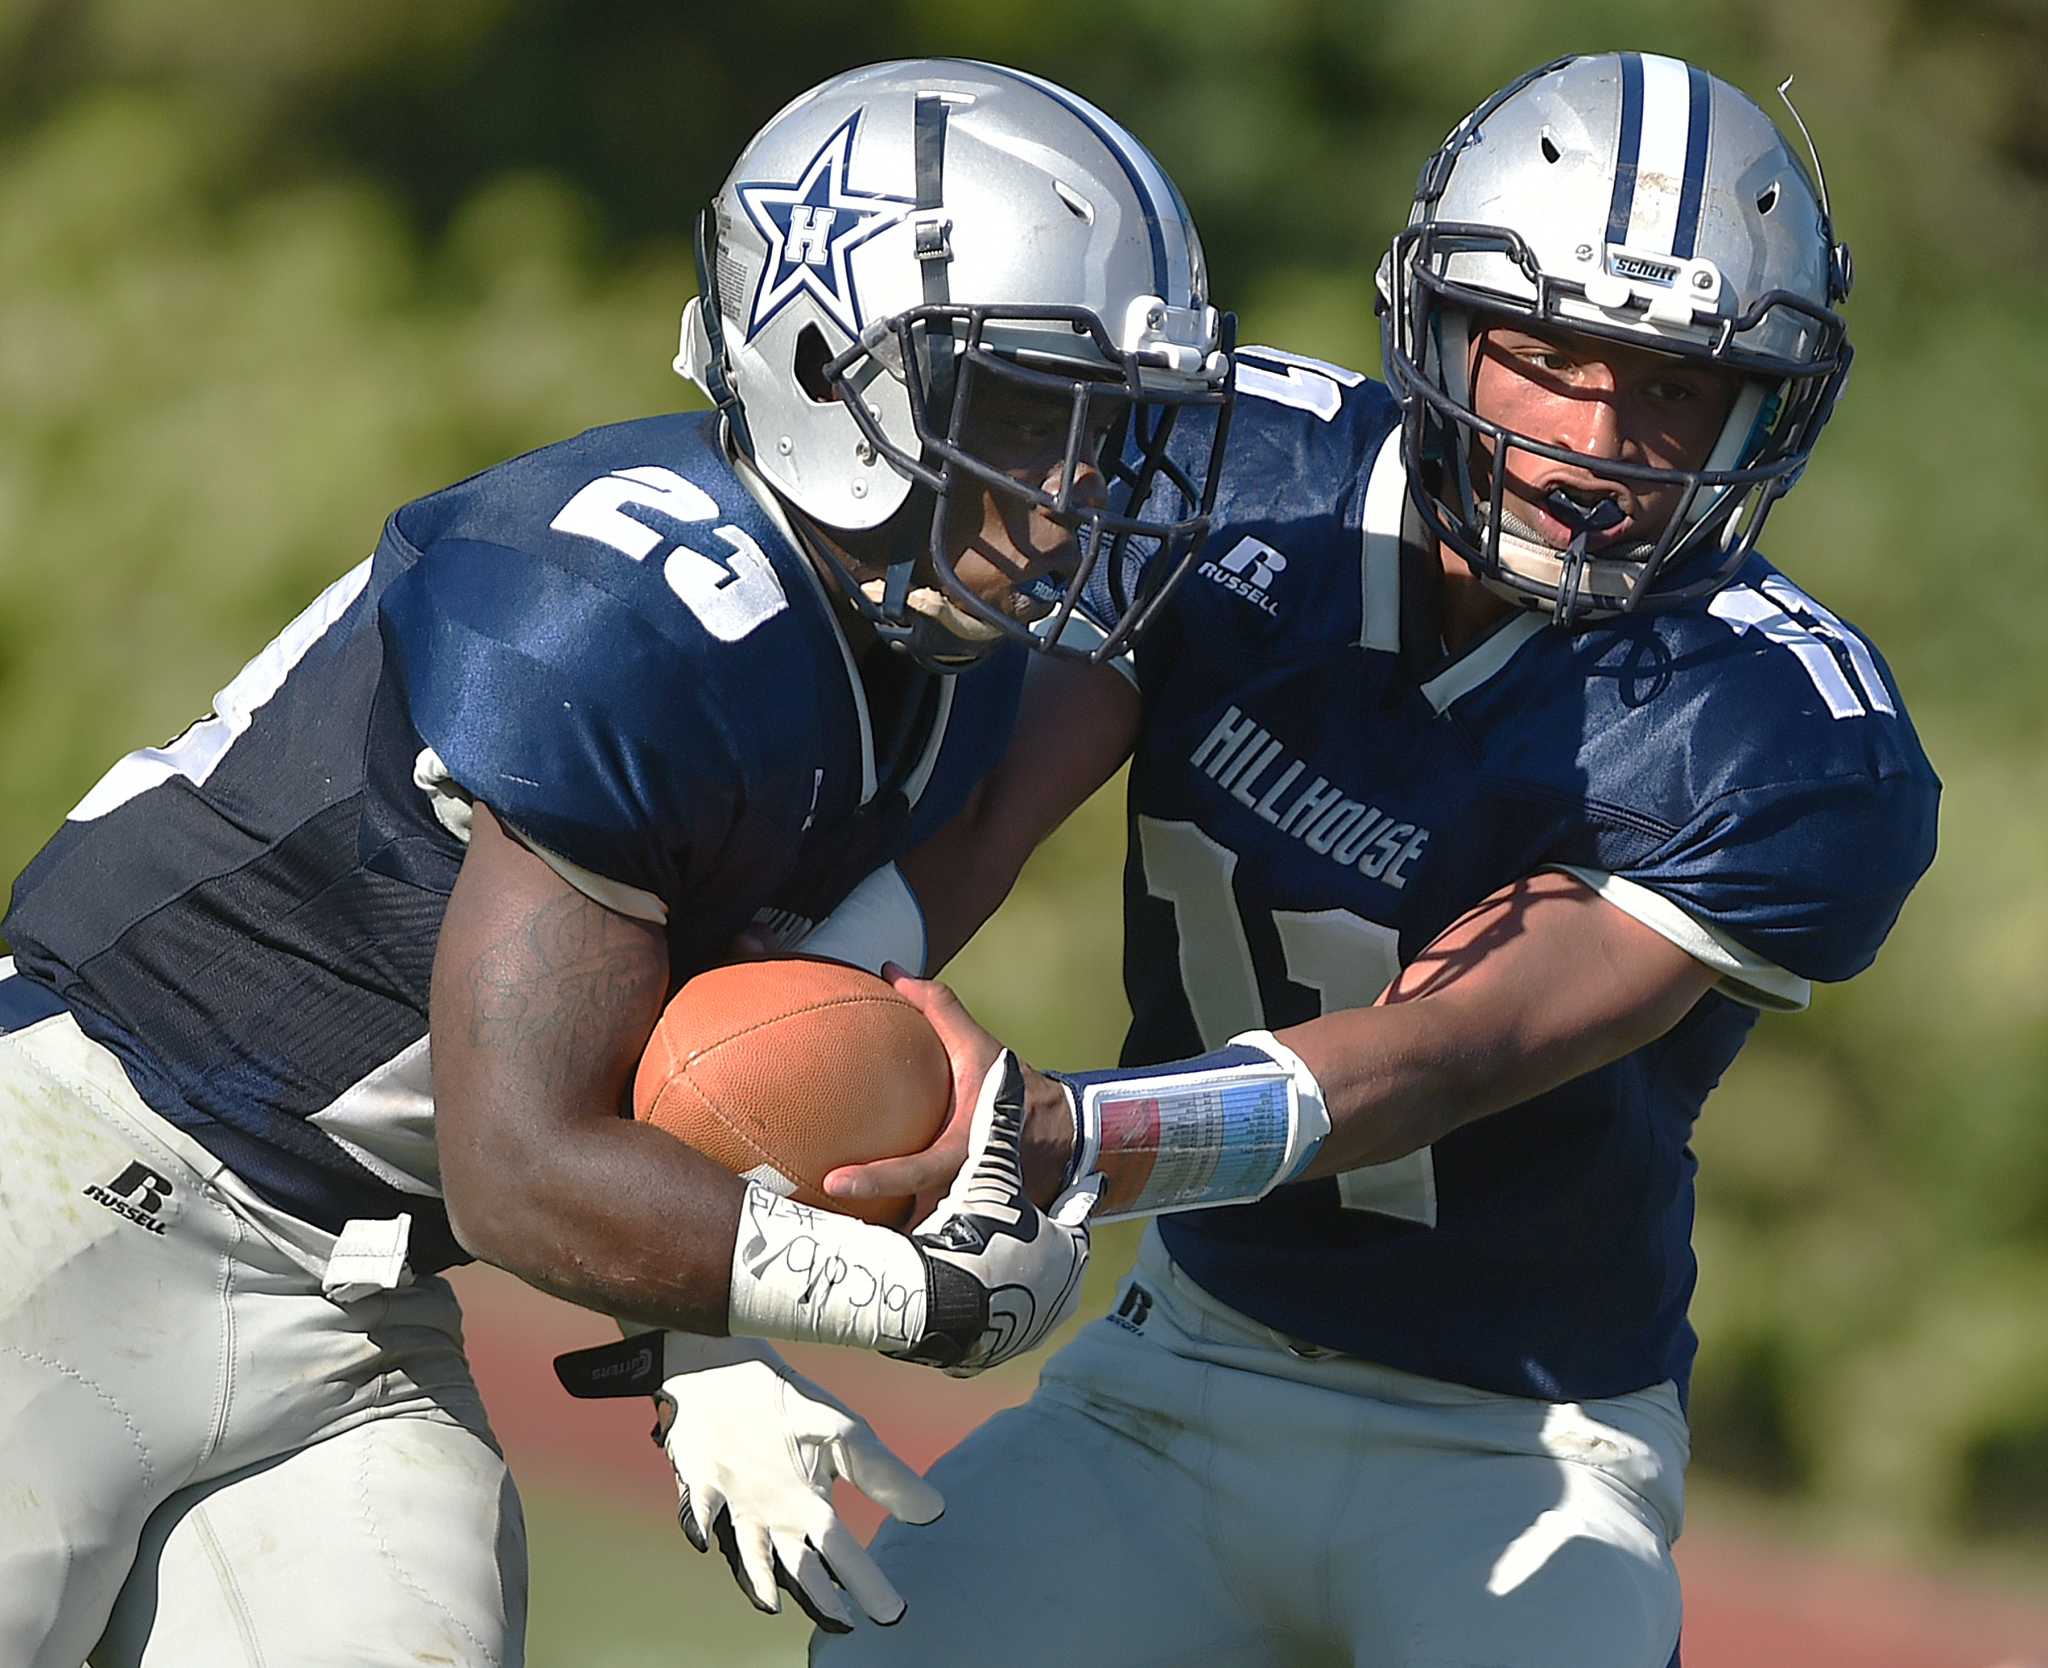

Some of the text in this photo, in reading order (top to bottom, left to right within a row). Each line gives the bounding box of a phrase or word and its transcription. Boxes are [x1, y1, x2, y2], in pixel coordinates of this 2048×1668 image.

[784, 204, 837, 264] H
[549, 465, 790, 643] 23
[1197, 560, 1281, 617] RUSSELL
[1188, 704, 1431, 890] HILLHOUSE
[82, 1184, 167, 1236] RUSSELL
